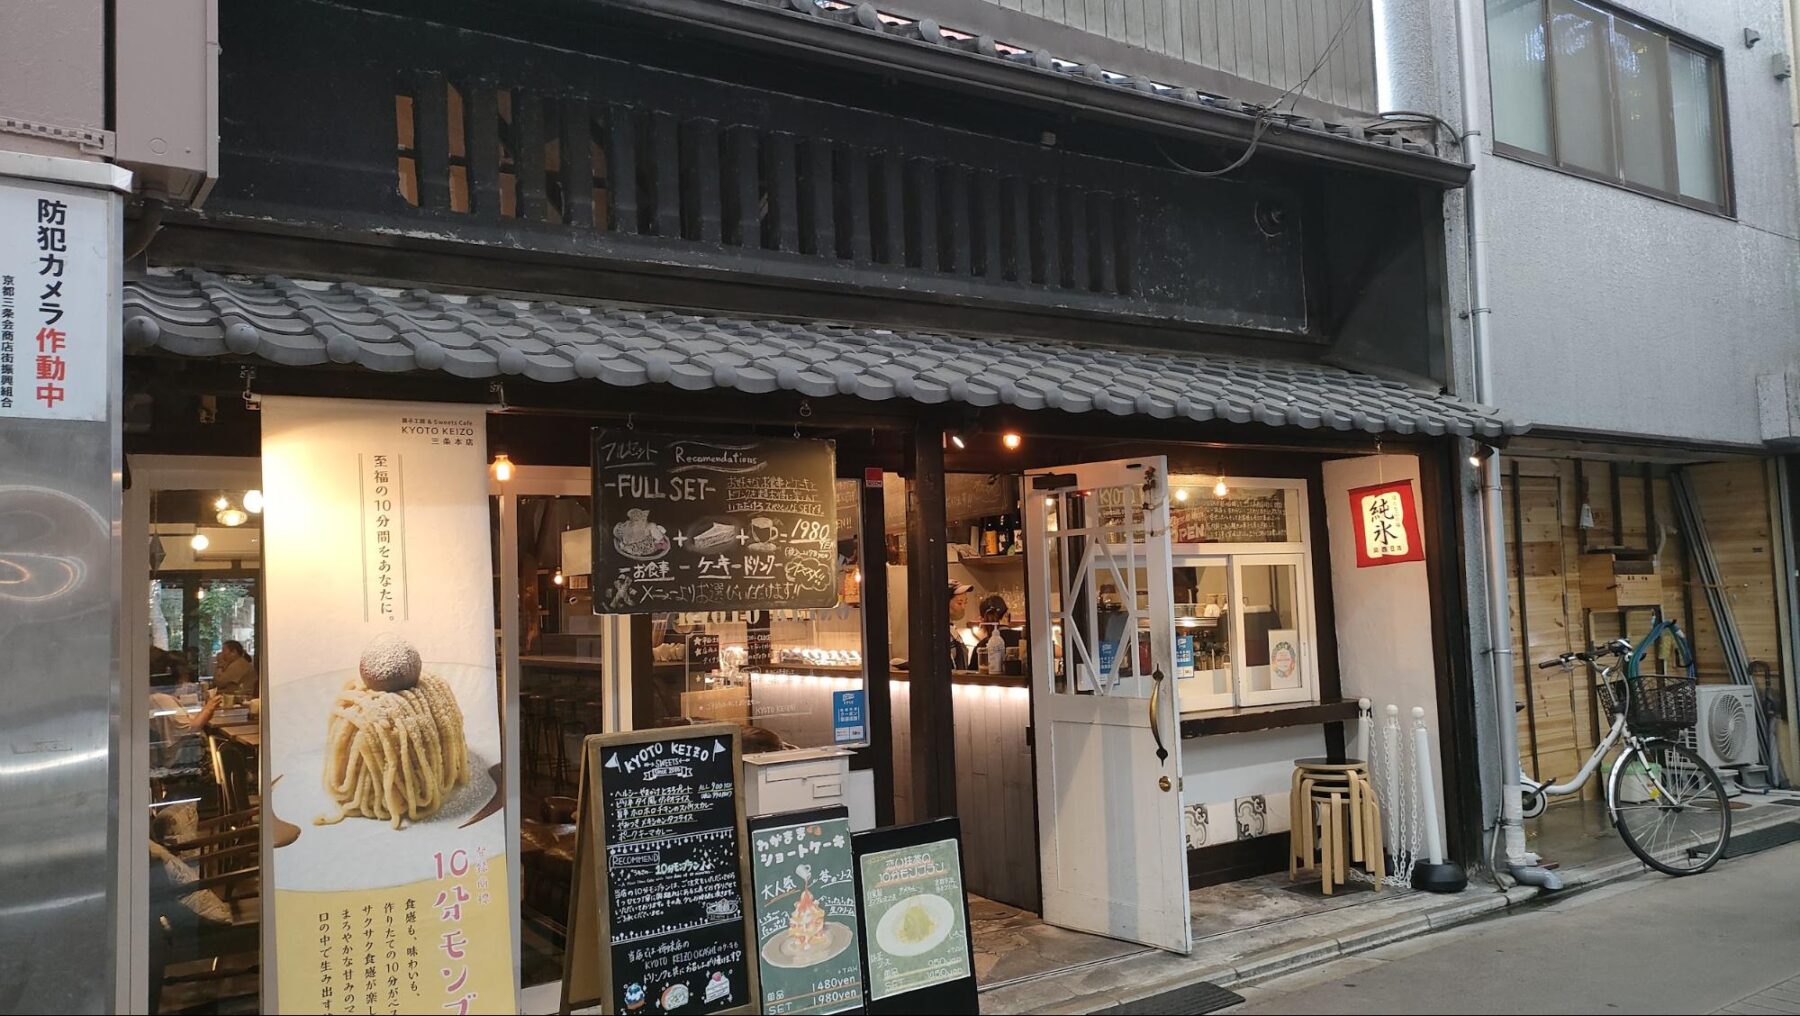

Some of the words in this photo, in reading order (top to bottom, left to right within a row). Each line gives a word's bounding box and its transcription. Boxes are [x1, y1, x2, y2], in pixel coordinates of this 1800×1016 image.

[36, 198, 68, 408] 防犯カメラ作動中
[1, 274, 15, 408] 京都三条会商店街振興組合
[402, 426, 439, 436] KYOTO
[442, 427, 474, 436] KEIZO
[431, 437, 474, 447] 三条本店
[676, 449, 758, 464] Recomendations
[618, 474, 667, 499] FULL
[669, 477, 708, 501] SET
[791, 518, 830, 541] 1980
[1369, 498, 1399, 546] 純氷
[373, 455, 395, 622] 至福の10分間をあなたに。
[633, 560, 672, 578] お食事
[698, 554, 732, 574] ケーキ
[744, 554, 775, 575] ドリンク
[624, 742, 663, 774] KYOTO
[671, 742, 709, 762] KEIZO
[655, 757, 680, 768] SWEETS
[756, 826, 806, 852] わがまま
[760, 834, 845, 867] ショートケーキ
[612, 854, 658, 866] RECOMMEND
[761, 875, 798, 900] 大人気
[405, 898, 421, 998] 食感も、味わいも、
[318, 912, 334, 1014] 口の中で生み出す
[645, 957, 668, 970] KYOTO
[673, 952, 692, 965] KEIZO
[812, 975, 856, 993] 1480yen
[768, 1001, 793, 1015] SET
[813, 988, 857, 1006] 1980yen
